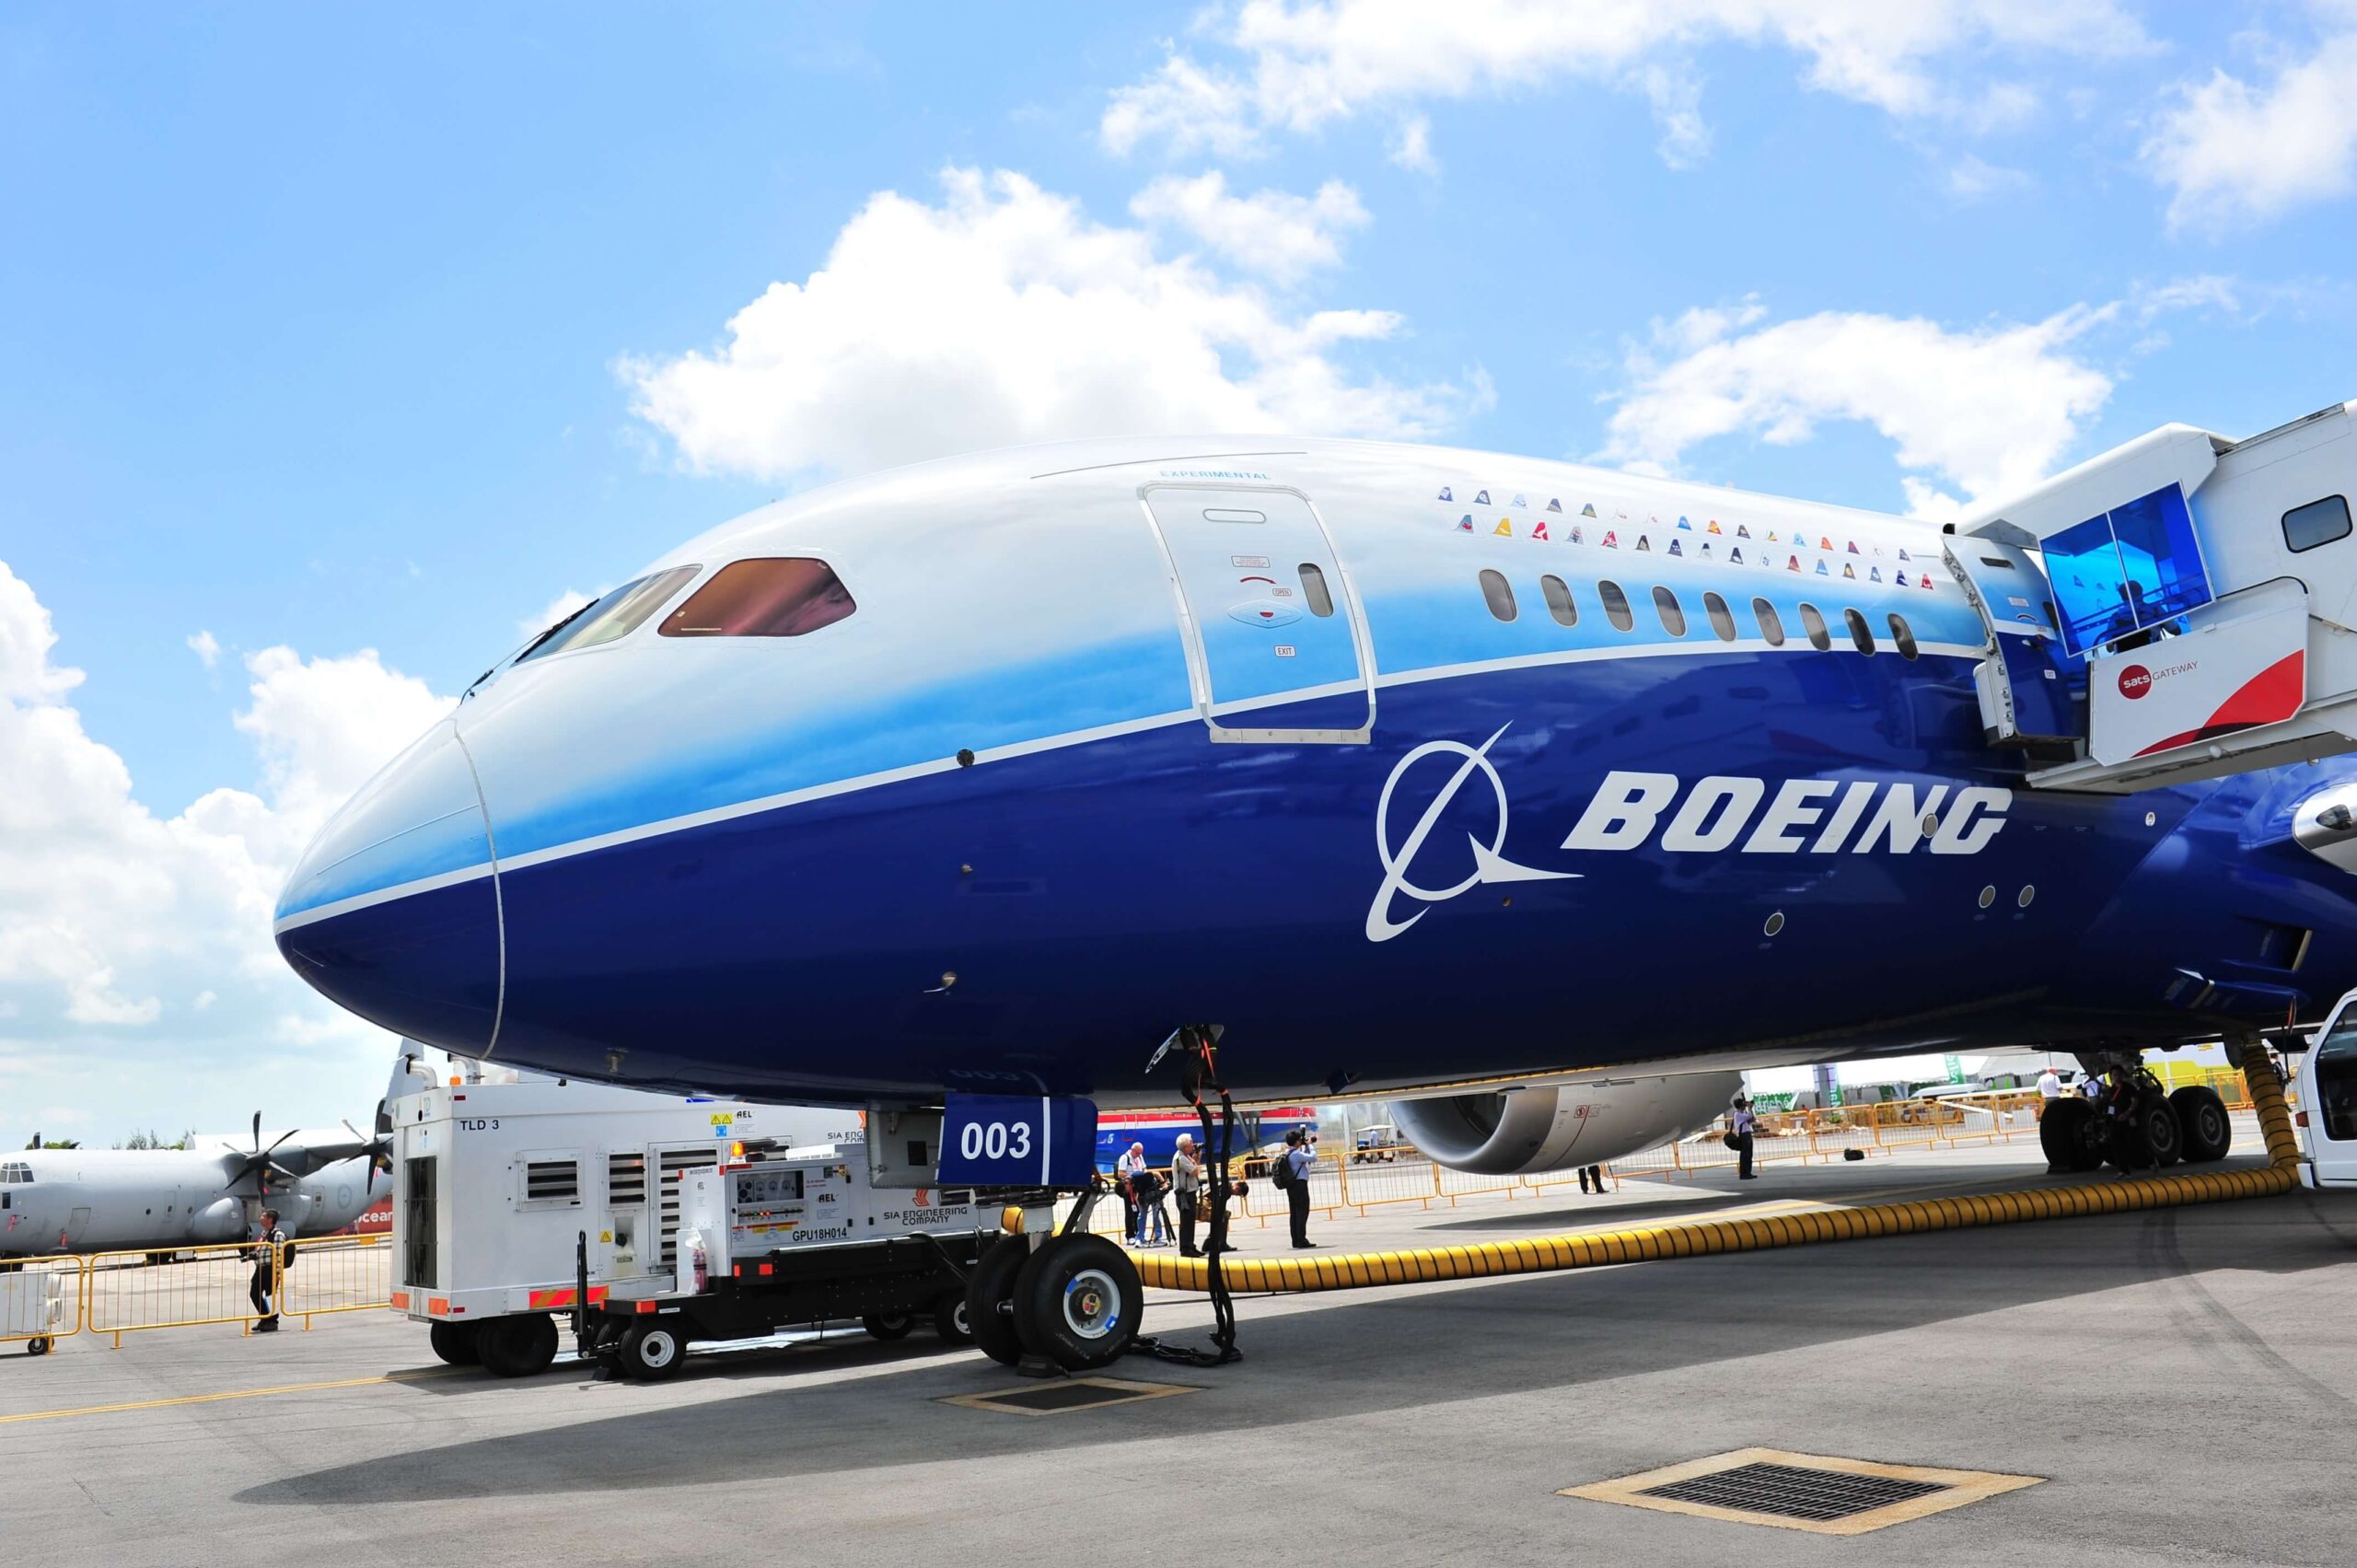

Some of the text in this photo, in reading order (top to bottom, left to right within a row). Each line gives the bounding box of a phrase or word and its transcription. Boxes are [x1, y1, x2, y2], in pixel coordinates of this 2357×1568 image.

[1160, 470, 1271, 480] EXPERIMENTAL
[1277, 647, 1292, 656] EXIT
[2123, 661, 2198, 689] sats GATEWAY
[1560, 771, 2014, 854] BOEING
[737, 1110, 752, 1119] AEL
[460, 1120, 499, 1131] TLD 3
[828, 1131, 864, 1140] SIA ENG
[961, 1121, 1031, 1160] 003
[818, 1194, 836, 1203] AEL
[884, 1207, 968, 1220] SIA ENGINEERING
[902, 1215, 949, 1225] COMPANY
[792, 1227, 847, 1242] GPU18H014
